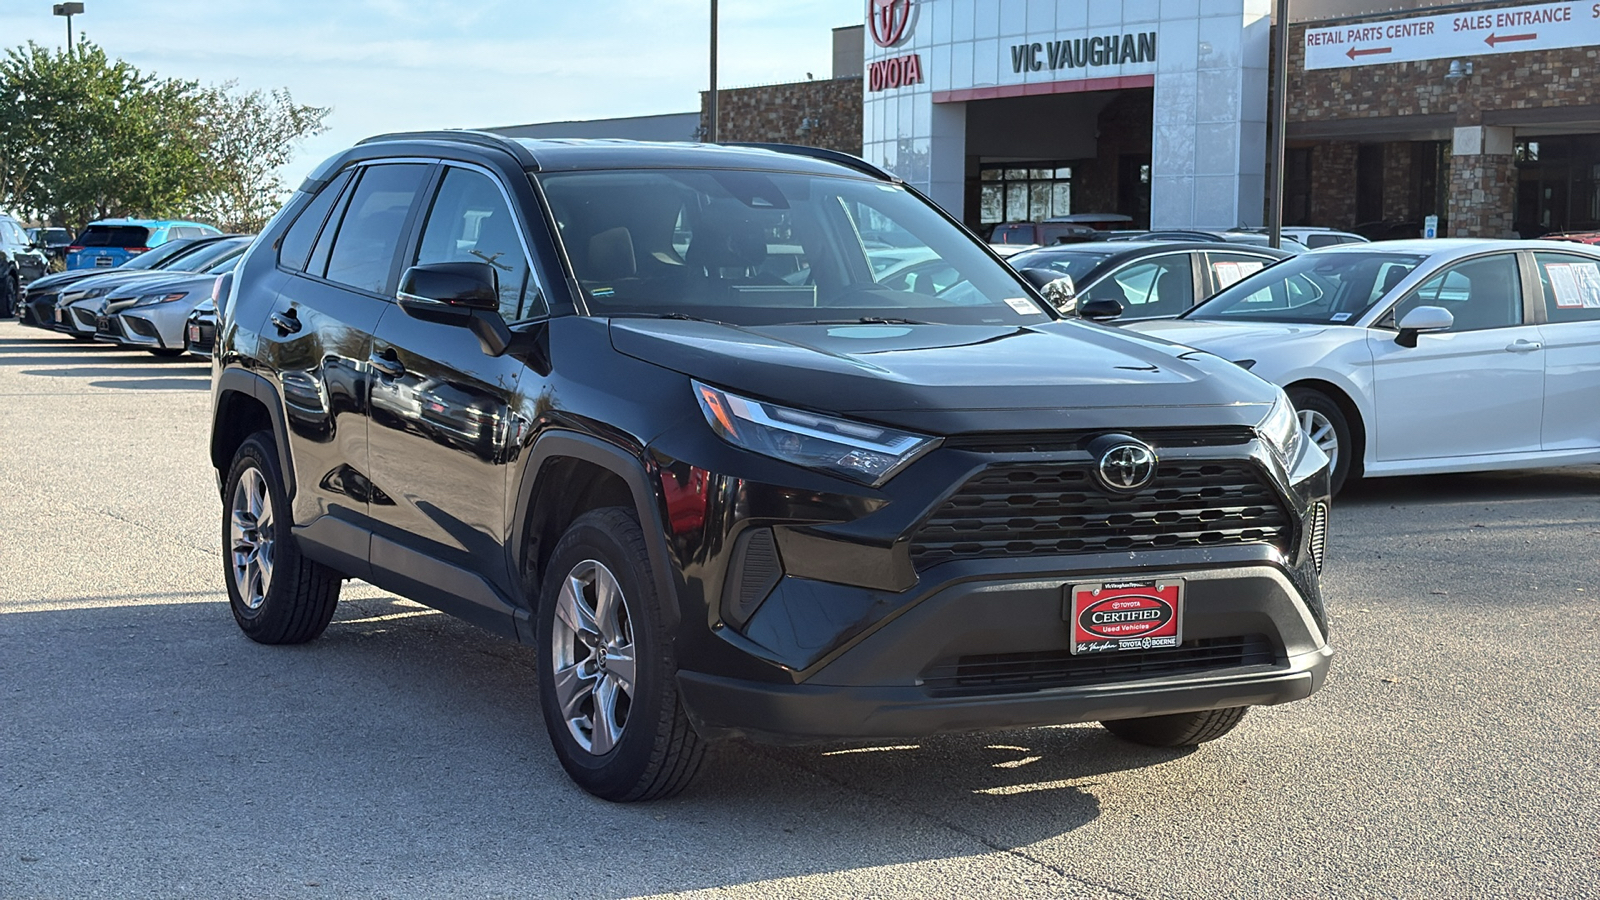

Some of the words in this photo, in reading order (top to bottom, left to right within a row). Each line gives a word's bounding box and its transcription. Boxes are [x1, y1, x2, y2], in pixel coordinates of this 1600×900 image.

[1453, 15, 1492, 32] SALES
[1496, 7, 1571, 28] ENTRANCE
[1307, 31, 1344, 47] RETAIL
[1347, 26, 1383, 43] PARTS
[1386, 21, 1435, 39] CENTER
[1011, 42, 1042, 73] VIC
[1046, 32, 1157, 70] VAUGHAN
[867, 54, 923, 92] TOYOTA
[1092, 610, 1161, 624] CERTIFIED
[1121, 623, 1149, 631] Vehicles
[1089, 641, 1118, 652] Vaughan
[1119, 640, 1142, 648] TOYOTA
[1151, 638, 1176, 646] BOERNE
